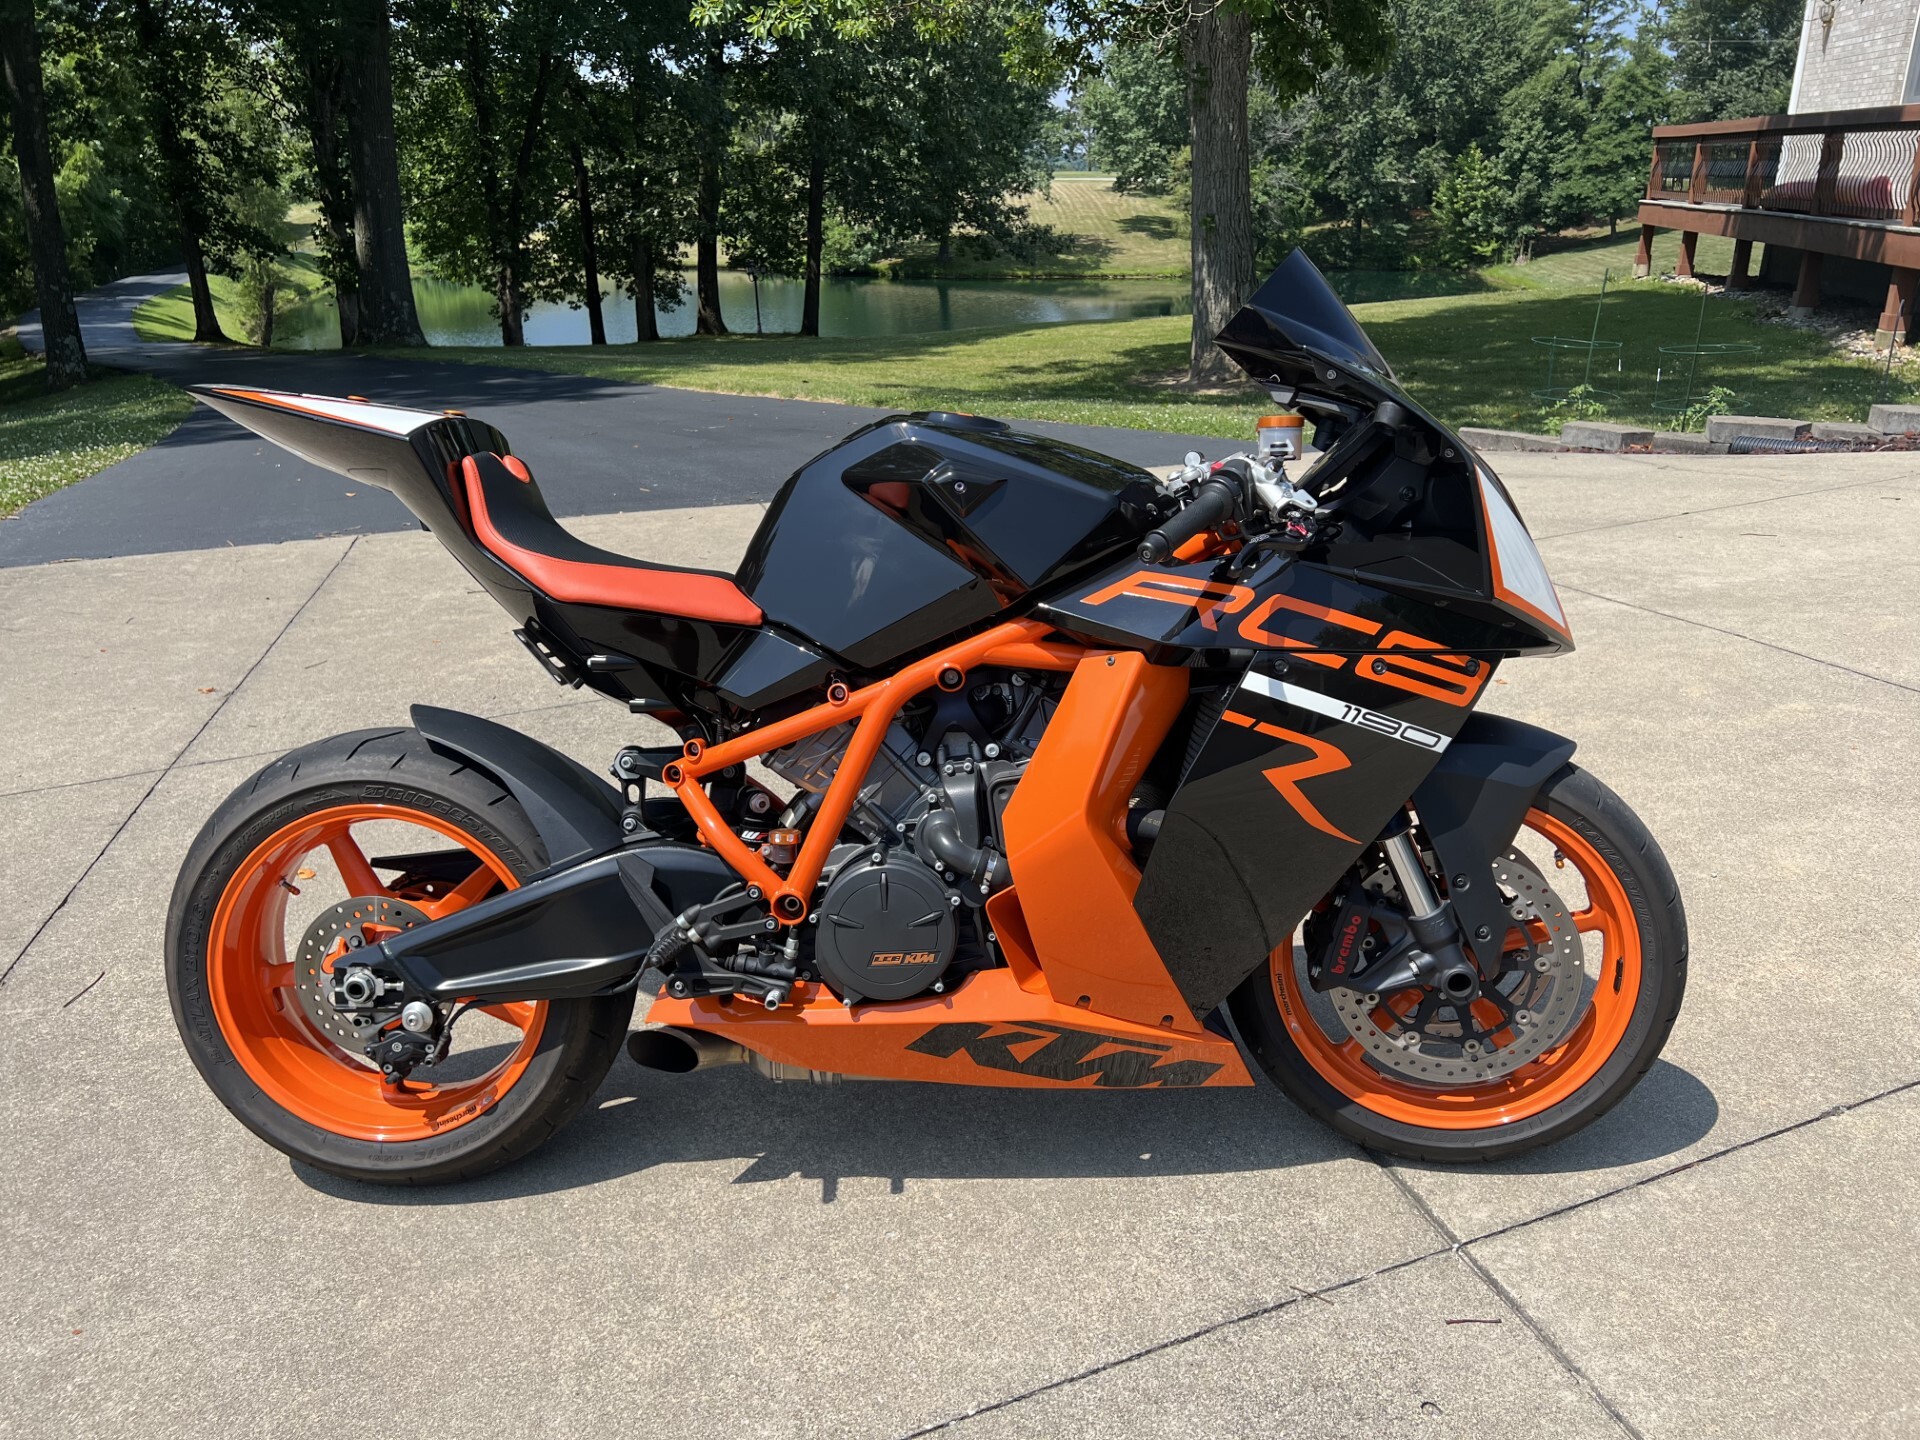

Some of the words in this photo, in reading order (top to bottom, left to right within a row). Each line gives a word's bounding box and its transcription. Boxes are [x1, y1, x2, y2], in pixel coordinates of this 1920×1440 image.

[1341, 703, 1442, 750] 1190
[903, 951, 936, 965] KTM
[1330, 915, 1363, 975] brembo
[1274, 972, 1293, 1016] marchesini
[904, 1020, 1226, 1088] KTM
